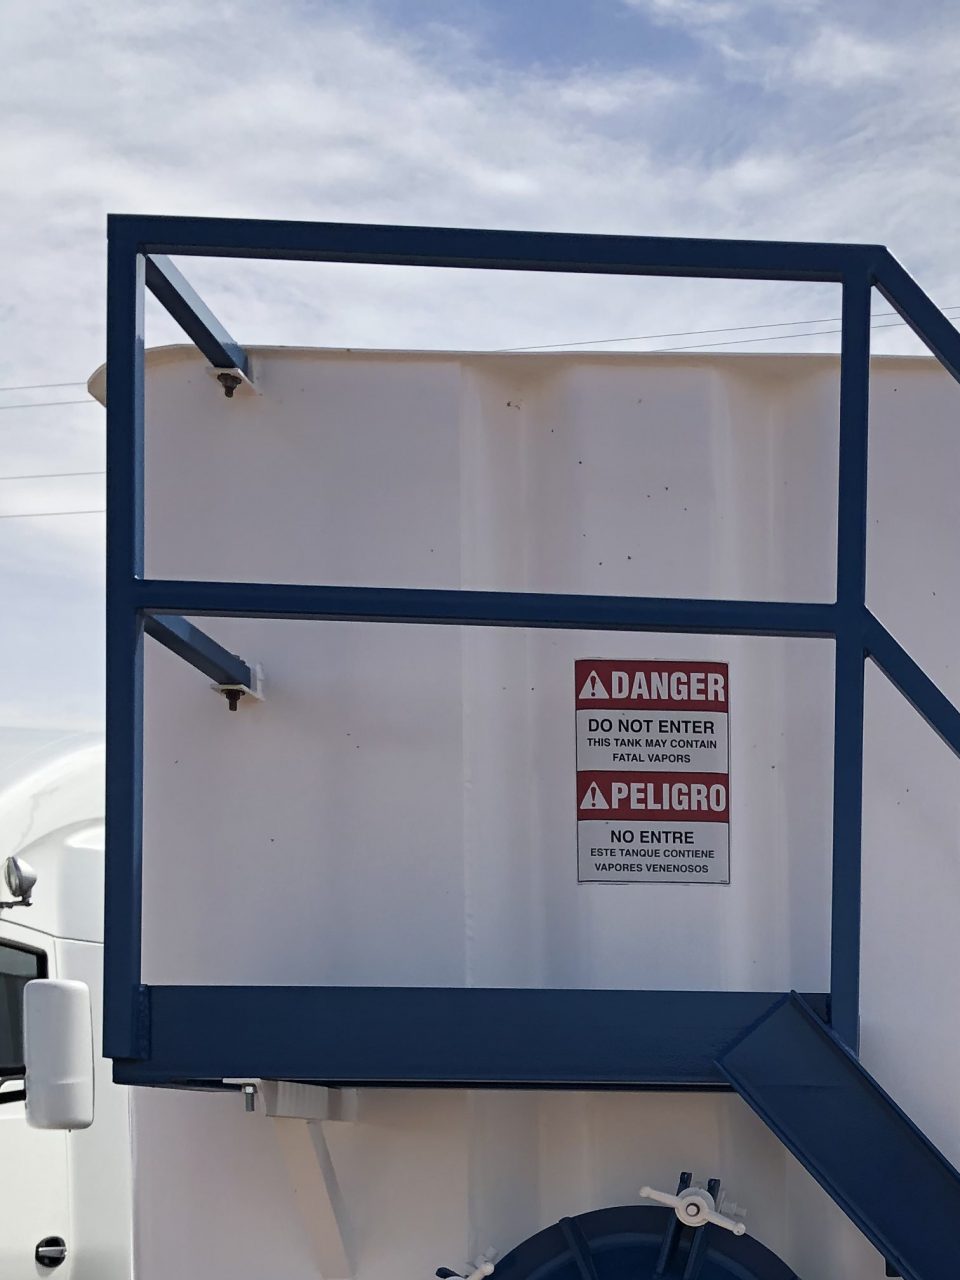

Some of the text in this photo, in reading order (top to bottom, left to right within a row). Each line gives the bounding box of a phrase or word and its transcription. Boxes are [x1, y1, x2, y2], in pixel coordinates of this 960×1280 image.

[611, 671, 725, 702] DANGER
[588, 719, 715, 734] DO NOT ENTER
[587, 738, 717, 749] THIS TANK MAY CONTAIN
[612, 753, 691, 764] FATAL VAPORS
[611, 782, 726, 812] PELIGRO
[610, 830, 694, 844] NO ENTRE
[590, 848, 715, 859] ESTE TANQUE CONTIENE
[594, 863, 709, 873] VAPORES VENENOSOS
